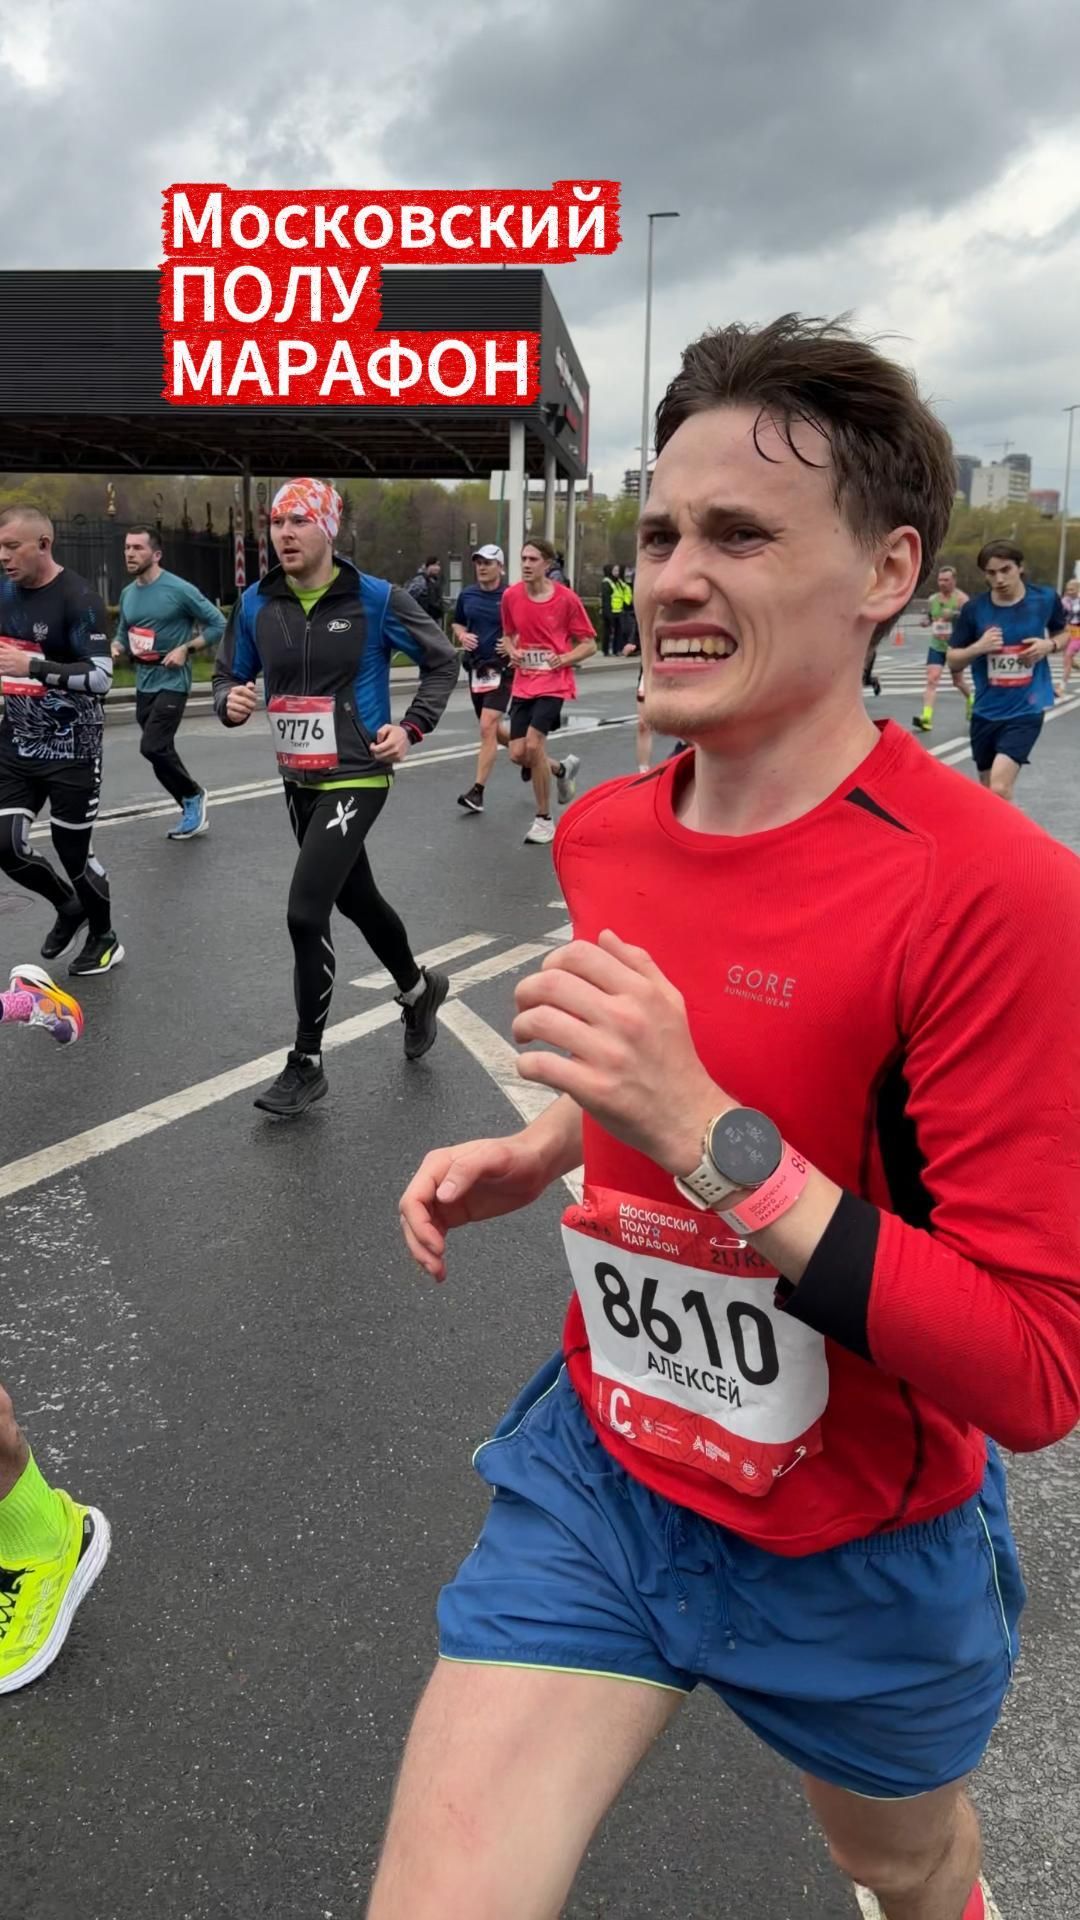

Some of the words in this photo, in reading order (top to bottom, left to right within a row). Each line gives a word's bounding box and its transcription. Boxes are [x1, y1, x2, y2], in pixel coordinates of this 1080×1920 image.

[276, 718, 324, 740] 9776
[727, 964, 797, 998] GORE
[765, 996, 791, 1009] WEAR
[619, 1202, 699, 1235] МОСКОВСКИЙ
[619, 1218, 651, 1236] ПОЛУ
[621, 1231, 680, 1256] МАРАФОН
[593, 1261, 780, 1386] 8610
[648, 1350, 742, 1408] АЛЕКСЕЙ
